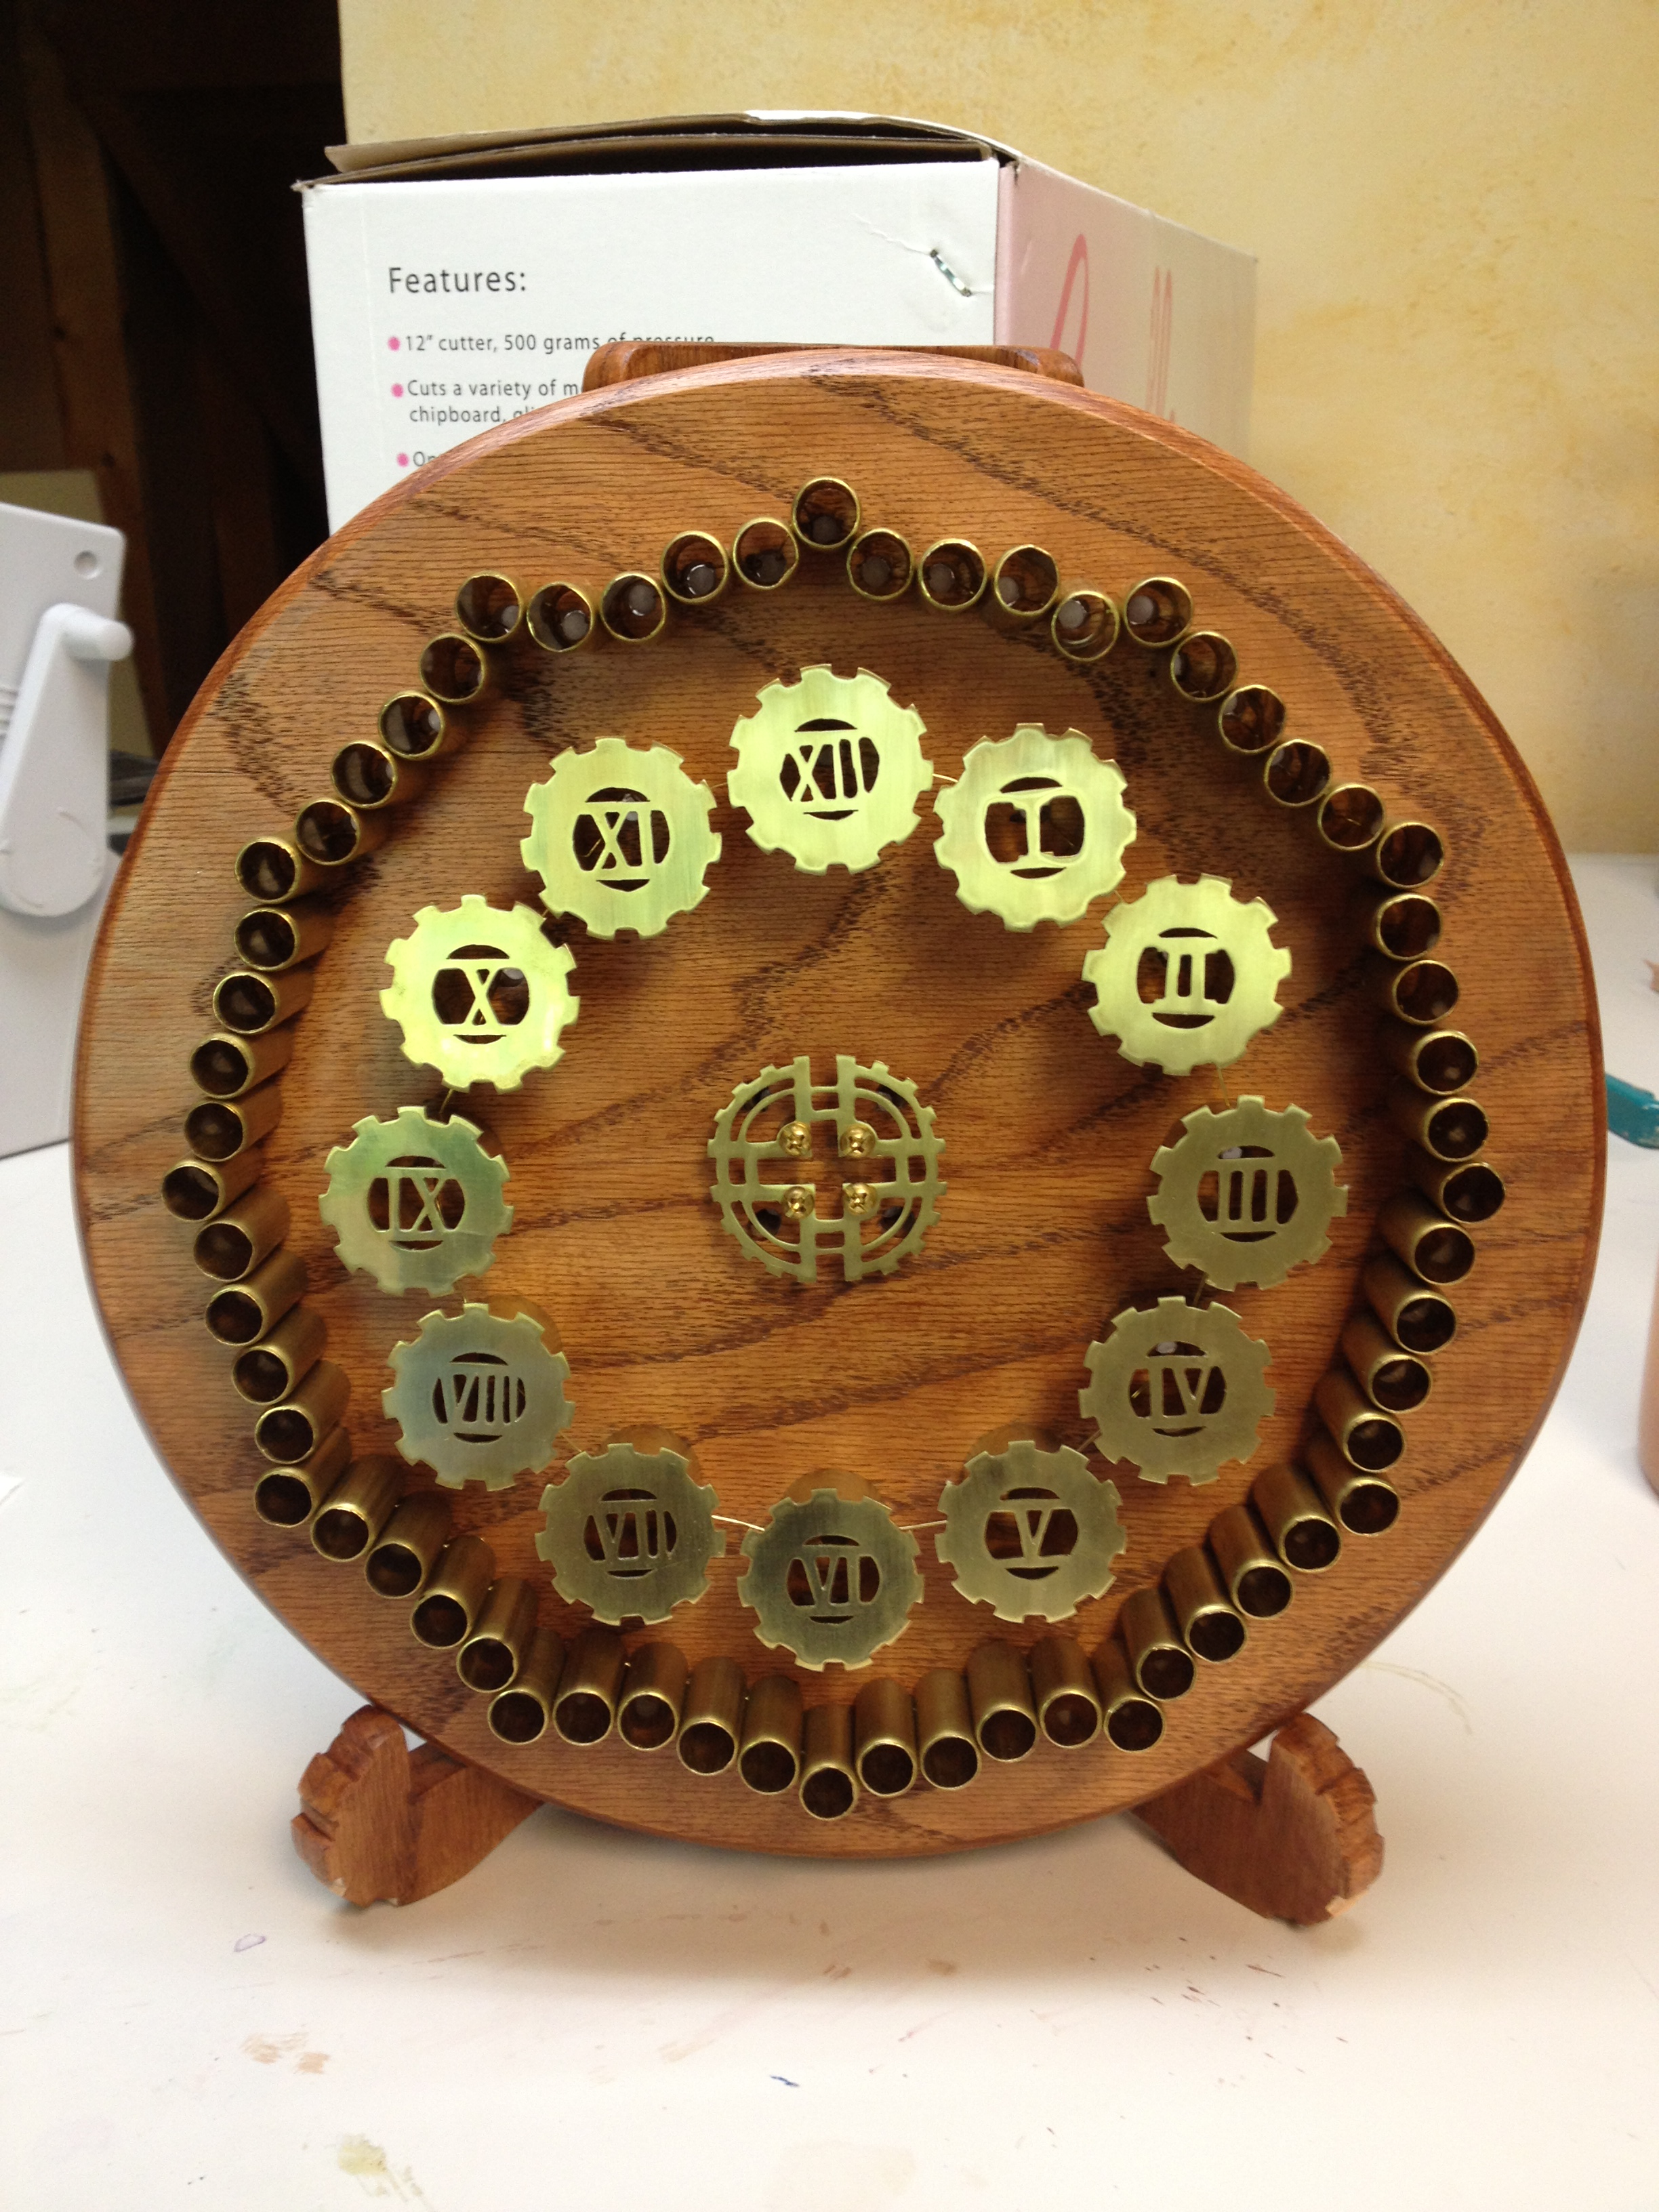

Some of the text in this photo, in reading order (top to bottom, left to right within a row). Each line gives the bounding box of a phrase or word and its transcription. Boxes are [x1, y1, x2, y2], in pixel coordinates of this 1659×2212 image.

[389, 267, 525, 293] Features:
[438, 335, 497, 352] cutter,
[504, 334, 536, 350] 500
[544, 337, 600, 354] grams
[408, 380, 446, 396] Cuts
[453, 384, 462, 396] a
[469, 380, 531, 400] variety
[538, 379, 556, 396] of
[784, 730, 870, 811] XII
[581, 802, 659, 880] XI
[451, 959, 512, 1036] X
[1152, 938, 1218, 1013] II
[384, 1168, 453, 1241] IX
[1214, 1158, 1281, 1233] III
[436, 1364, 522, 1433] VIII
[1145, 1357, 1218, 1429] IV
[590, 1501, 671, 1571] VII
[1002, 1499, 1064, 1568] V
[796, 1545, 867, 1617] VI
